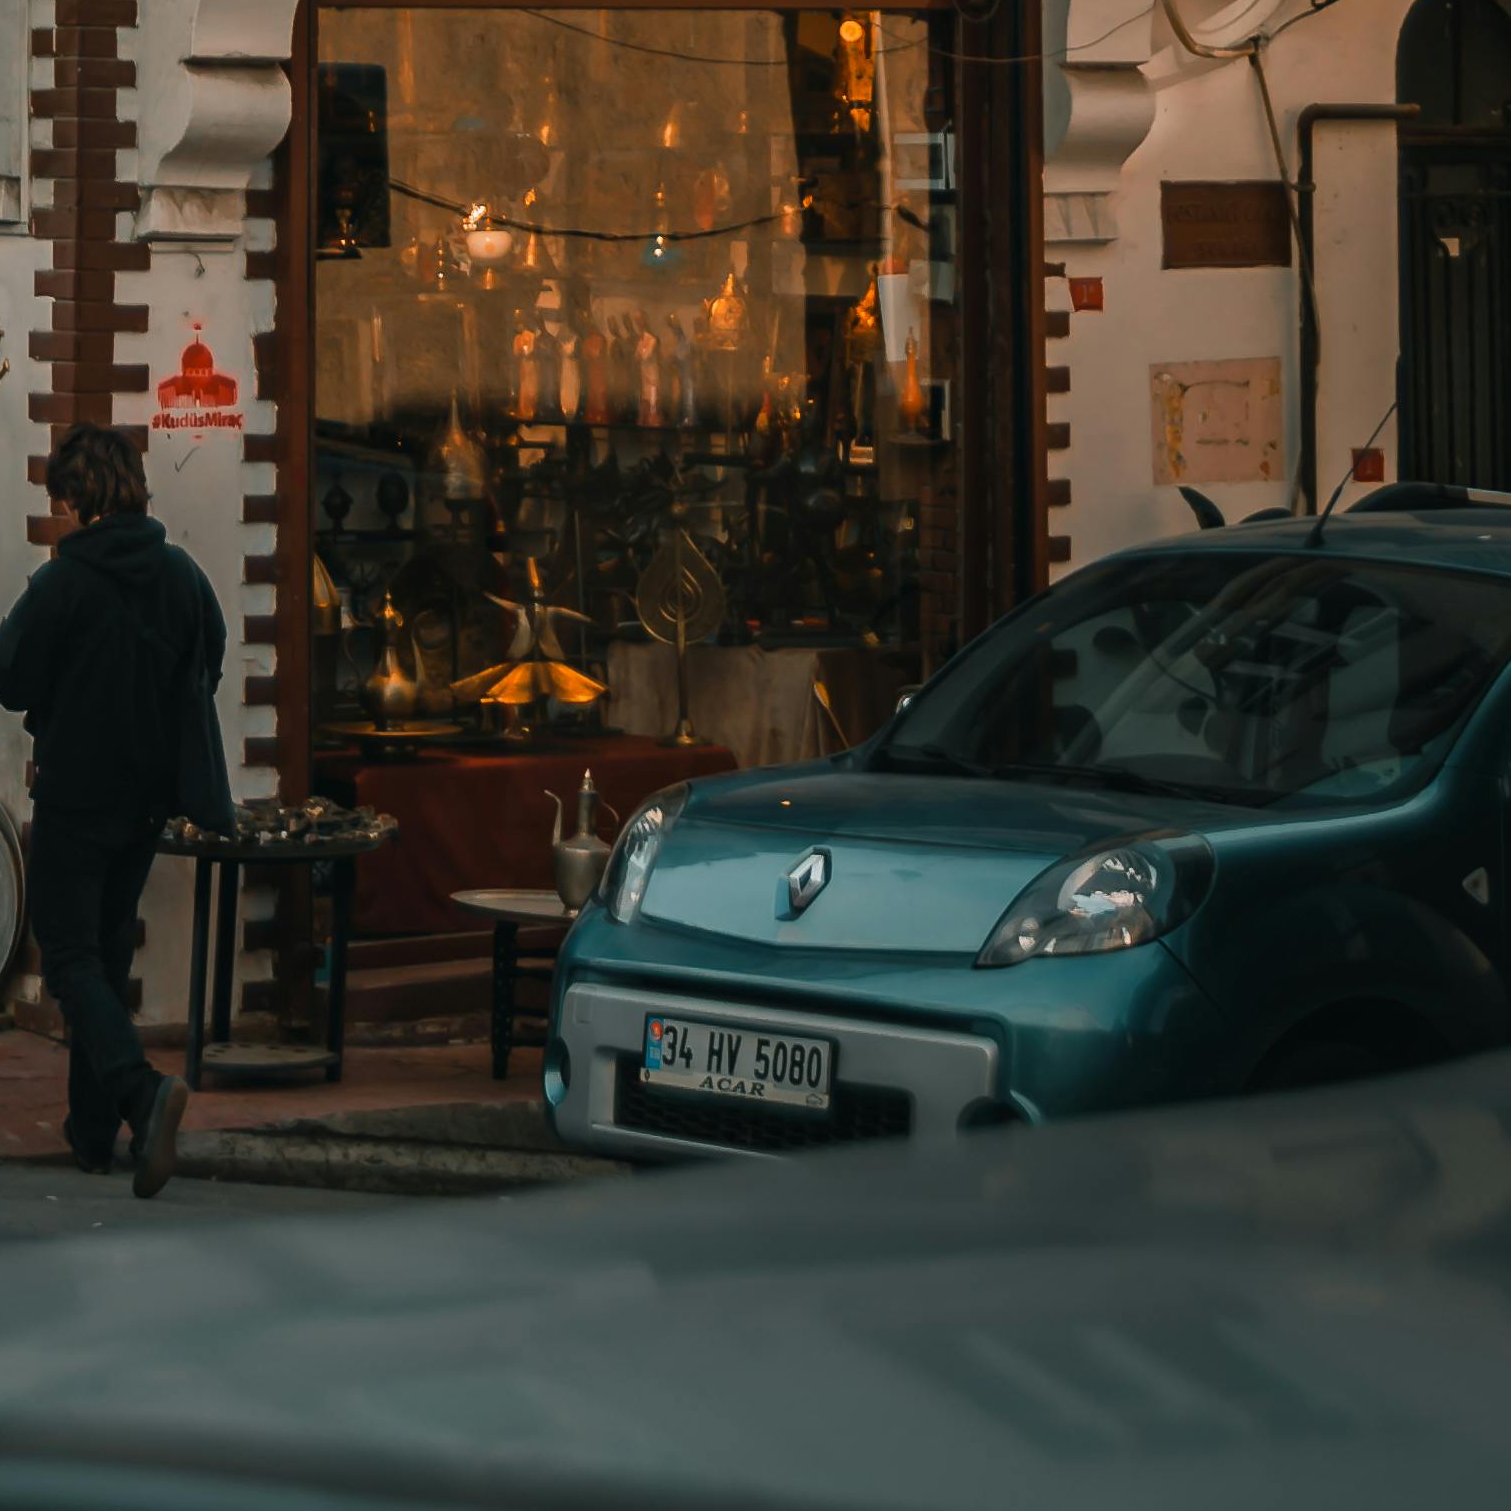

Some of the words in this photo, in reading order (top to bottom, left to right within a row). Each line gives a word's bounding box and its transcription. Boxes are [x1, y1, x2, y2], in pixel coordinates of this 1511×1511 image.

[151, 411, 244, 430] #KudüsMiraç
[661, 1026, 693, 1069] 34
[707, 1031, 742, 1076] HV
[753, 1037, 823, 1089] 5080
[699, 1075, 766, 1098] ACAR
